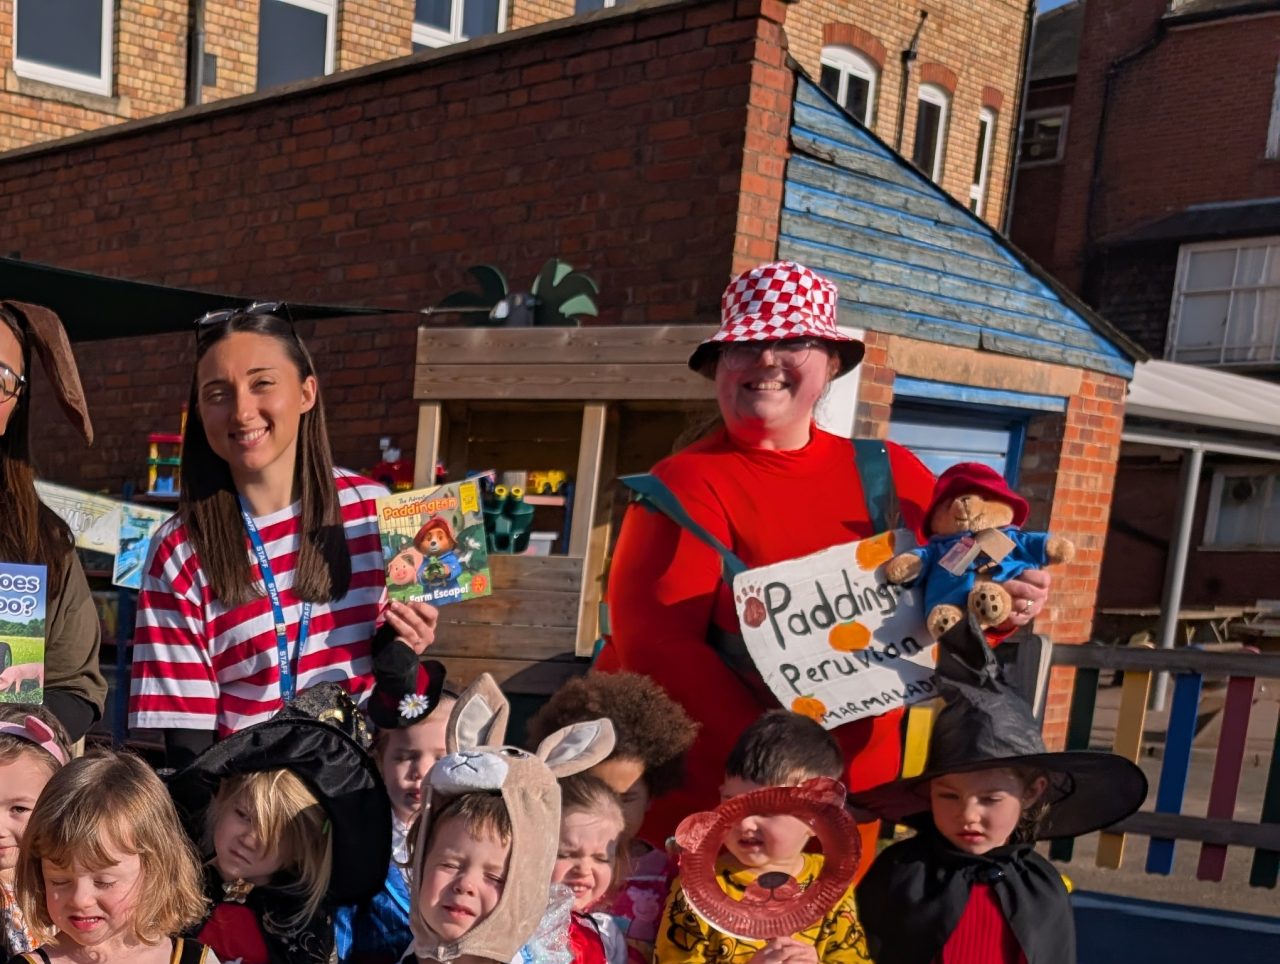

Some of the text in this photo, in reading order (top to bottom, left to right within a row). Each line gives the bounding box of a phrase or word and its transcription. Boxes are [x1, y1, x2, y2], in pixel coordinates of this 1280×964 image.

[383, 497, 458, 520] Paddington
[256, 546, 269, 568] STAFF
[268, 583, 280, 606] STAFF
[409, 592, 433, 602] Farm
[434, 584, 469, 599] Escape!
[279, 651, 289, 675] STAFF
[779, 636, 924, 697] Peruvian
